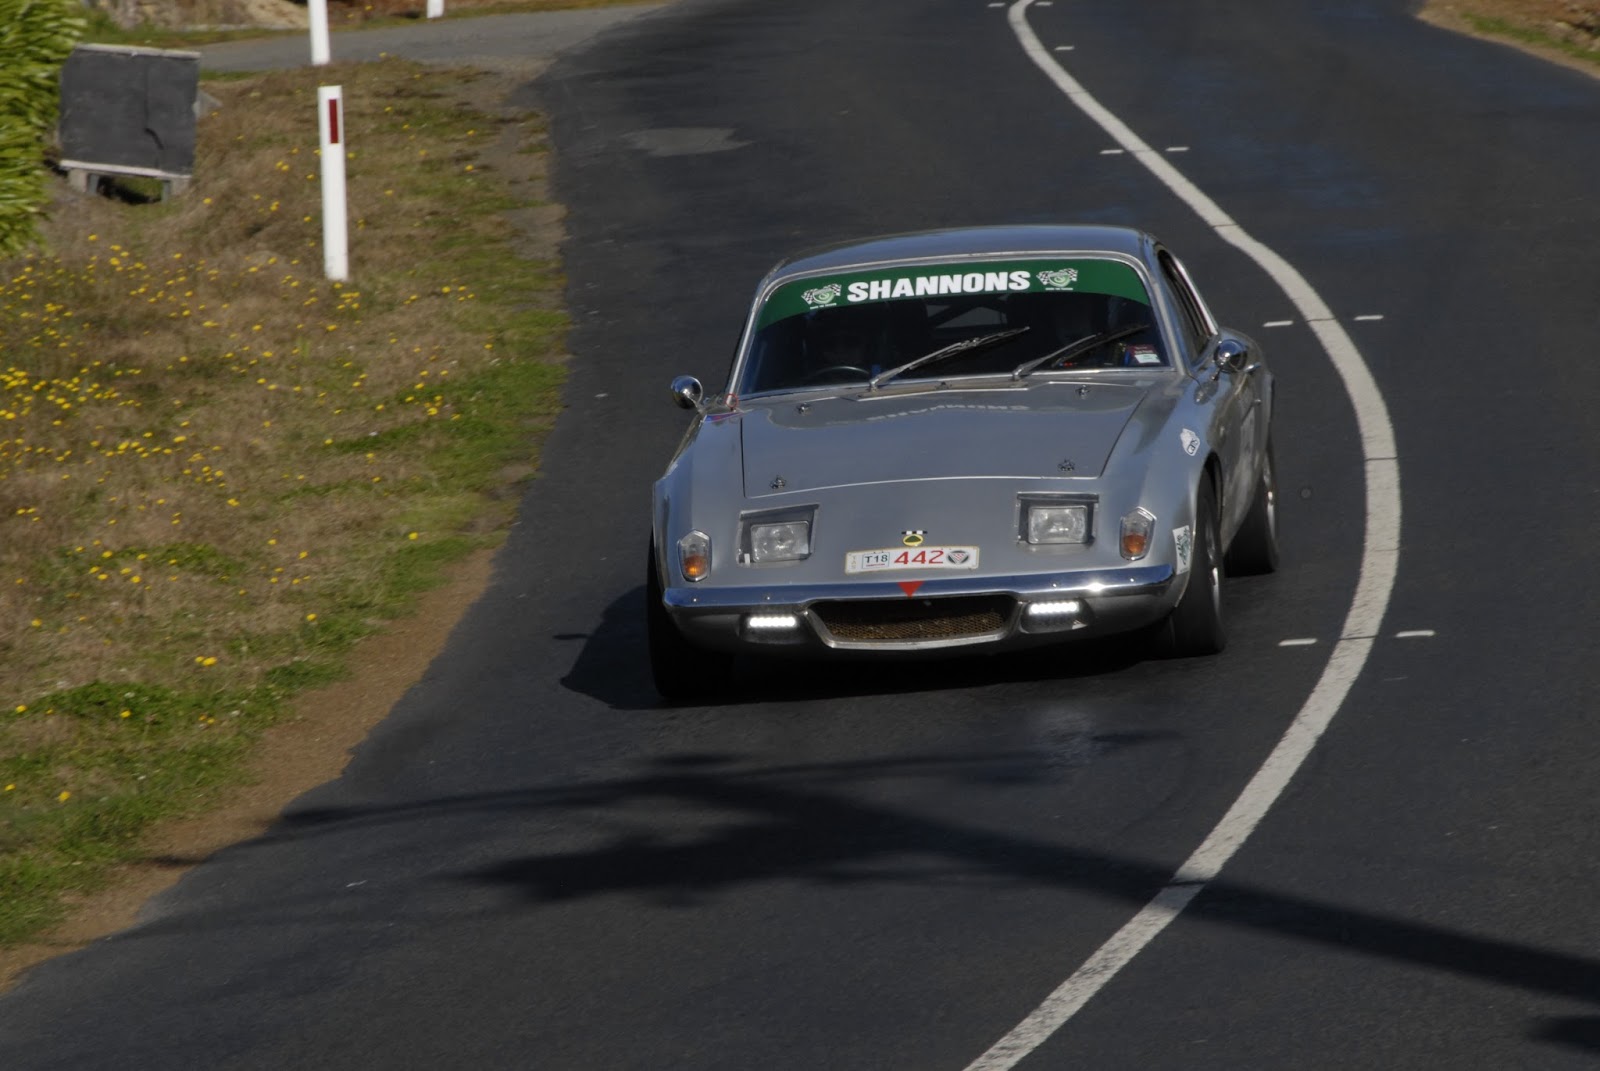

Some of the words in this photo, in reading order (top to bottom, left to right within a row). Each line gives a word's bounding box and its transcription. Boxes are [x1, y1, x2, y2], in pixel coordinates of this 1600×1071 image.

[847, 270, 1031, 302] SHANNONS
[864, 554, 888, 563] T18
[894, 550, 944, 565] 442
